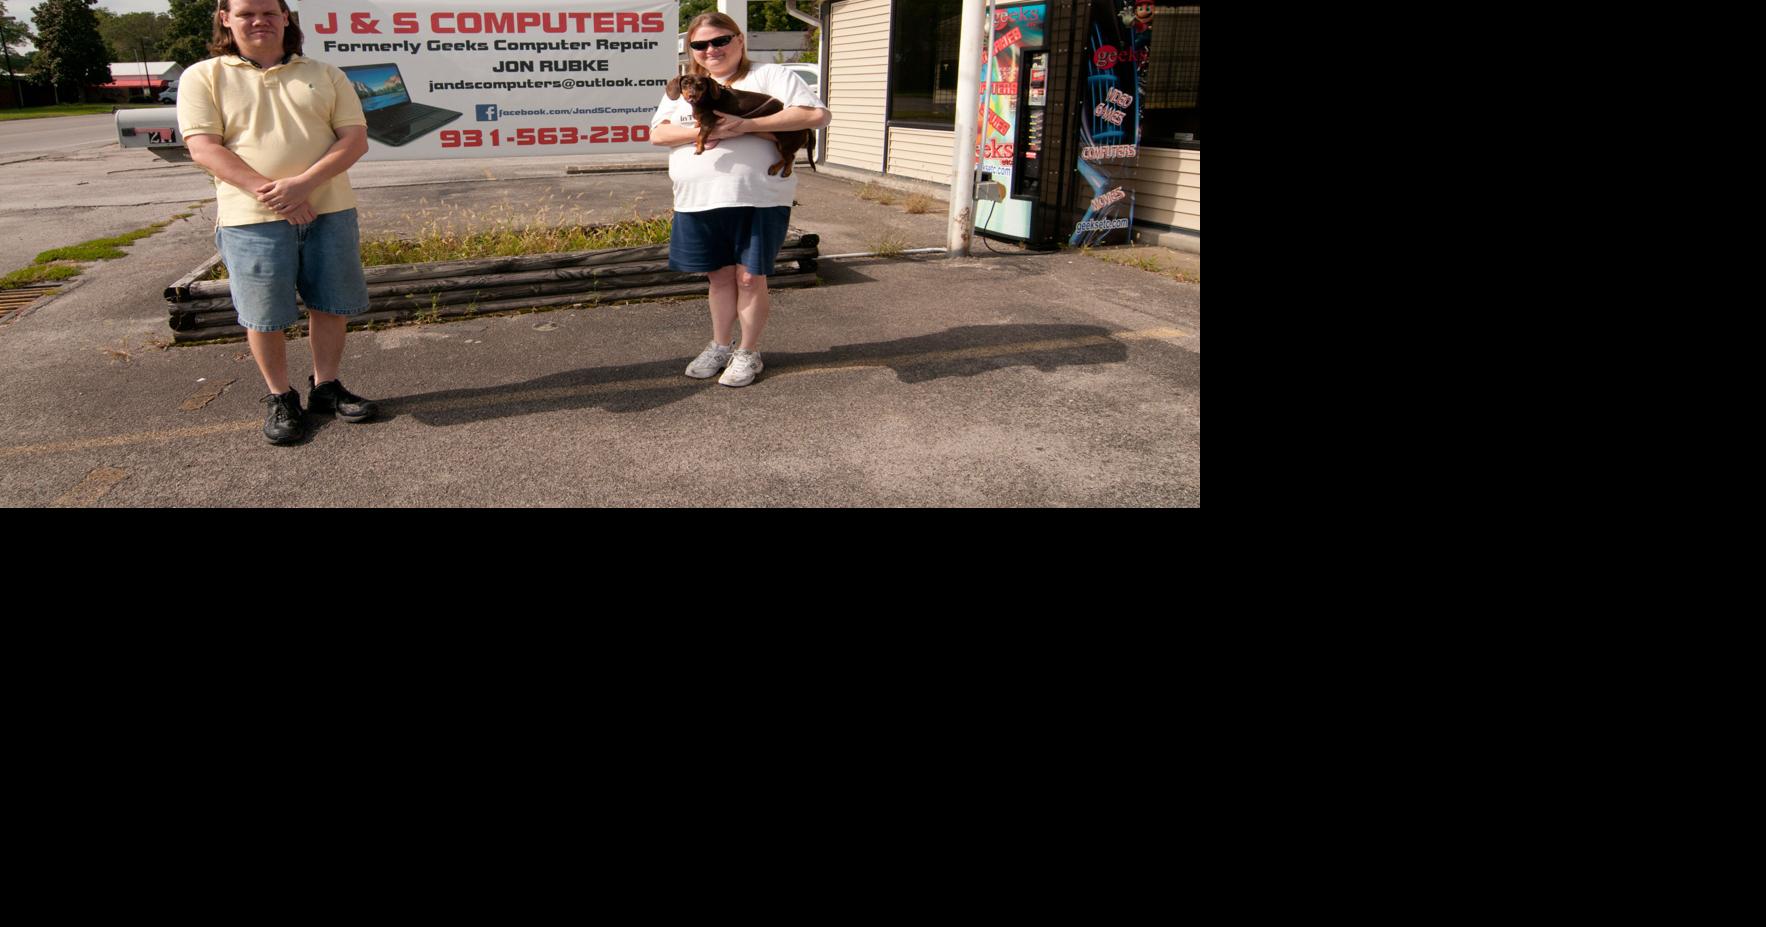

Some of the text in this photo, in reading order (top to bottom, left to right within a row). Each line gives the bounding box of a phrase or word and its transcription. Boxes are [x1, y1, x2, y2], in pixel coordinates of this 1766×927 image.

[315, 12, 664, 34] J & S COMPUTERS
[324, 39, 658, 54] Formerly Geeks Computer Repair
[492, 60, 609, 73] JON RUBKE
[429, 78, 668, 93] jandscomputers@outlook.com
[499, 106, 658, 118] facebook.com/JandSComputerT
[440, 125, 650, 148] 931-563-230
[1082, 145, 1136, 160] COMPUTERS
[1091, 186, 1126, 212] MOVIES
